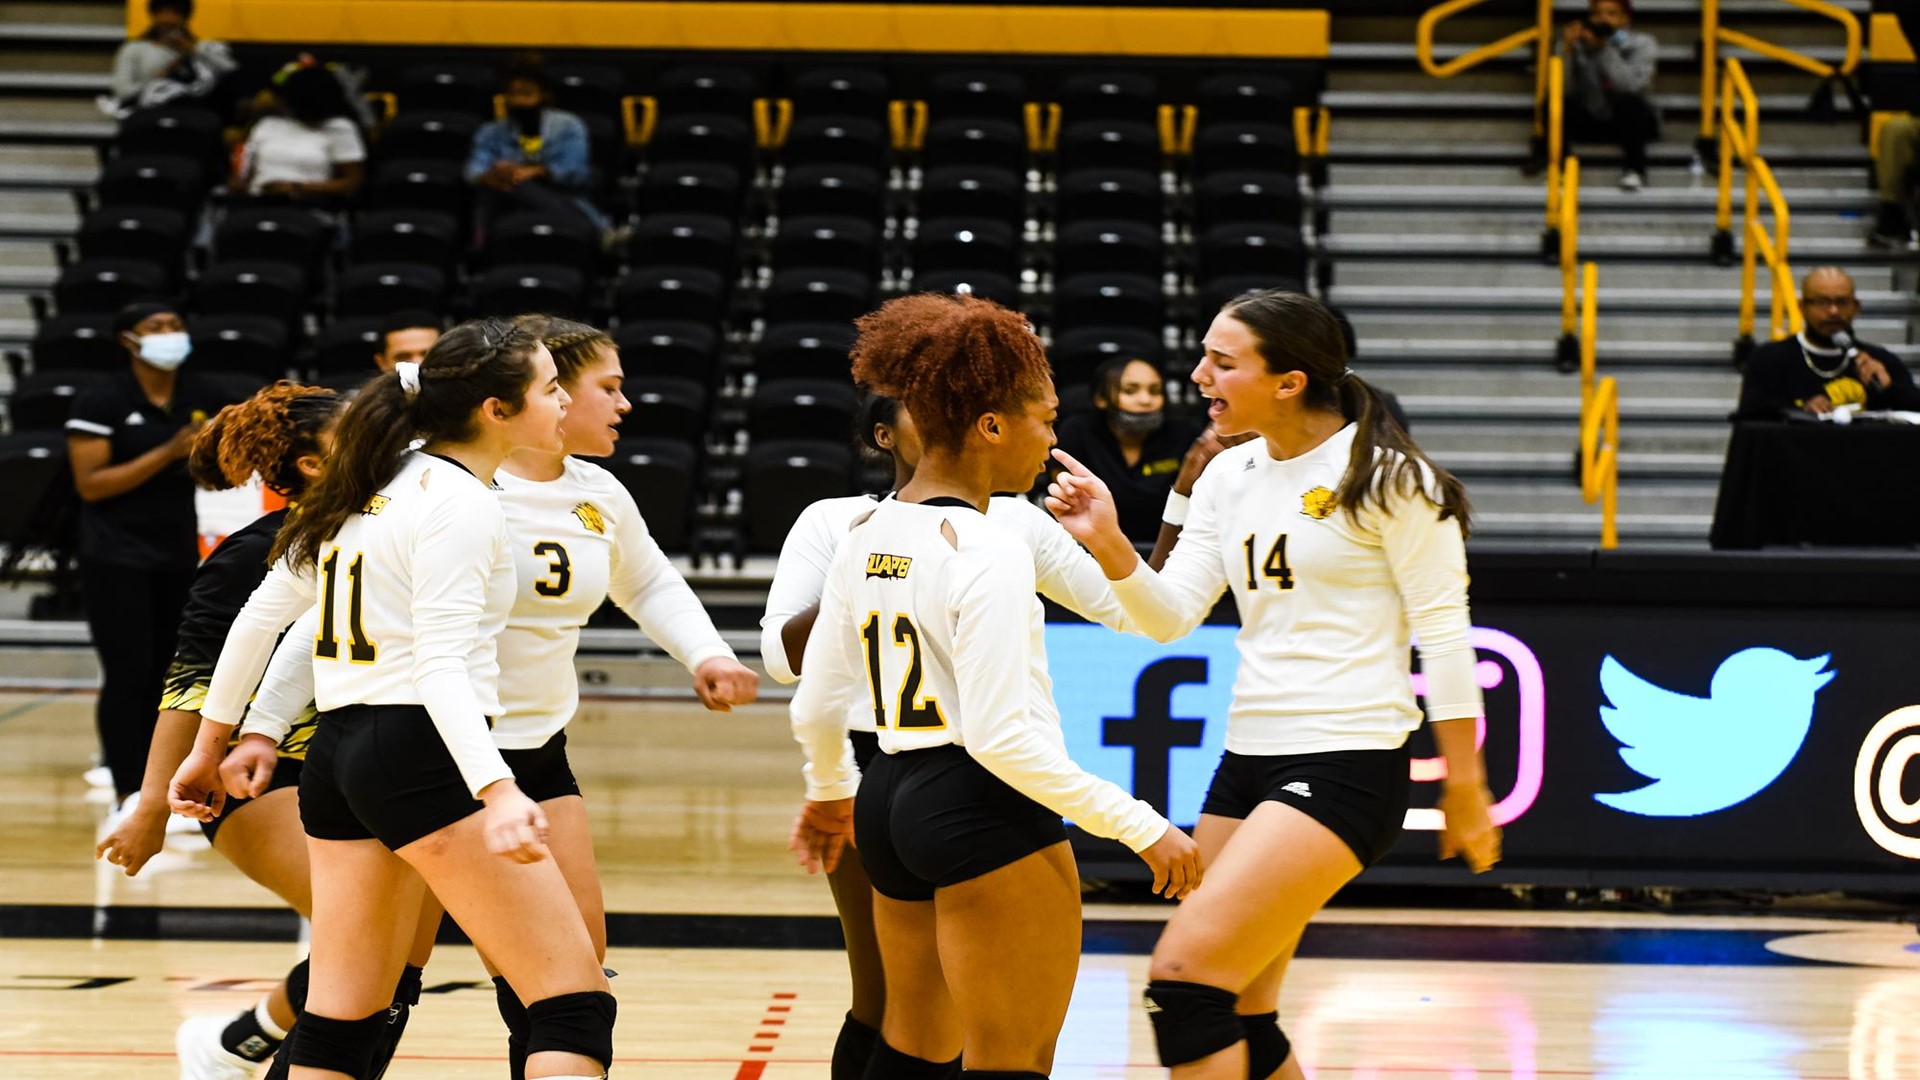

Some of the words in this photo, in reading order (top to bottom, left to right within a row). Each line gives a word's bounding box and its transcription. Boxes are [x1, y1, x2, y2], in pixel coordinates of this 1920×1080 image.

[533, 541, 573, 597] 3
[866, 553, 913, 580] UAPB
[1243, 532, 1295, 592] 14
[313, 546, 378, 664] 11
[861, 609, 946, 730] 12
